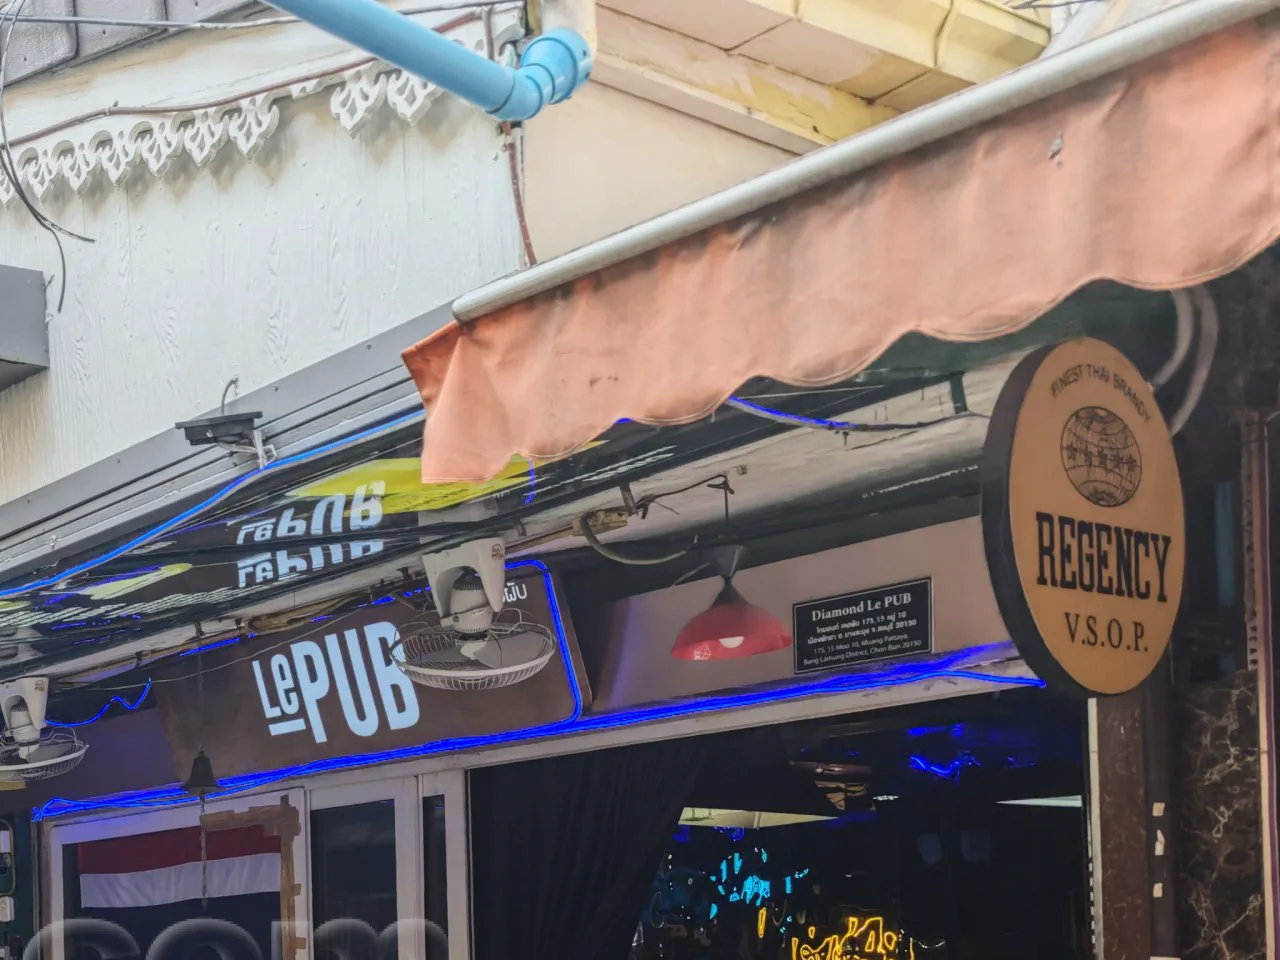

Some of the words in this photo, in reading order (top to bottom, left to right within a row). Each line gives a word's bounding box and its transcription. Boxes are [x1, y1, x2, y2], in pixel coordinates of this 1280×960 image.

[1050, 363, 1083, 398] FINEST
[1086, 363, 1110, 383] THAI
[1113, 373, 1152, 424] BRANDY
[1036, 511, 1172, 603] REGENCY
[811, 601, 864, 621] Diamond
[867, 599, 881, 611] Le
[884, 592, 912, 608] PUB
[1064, 611, 1149, 652] V.S.O.P.
